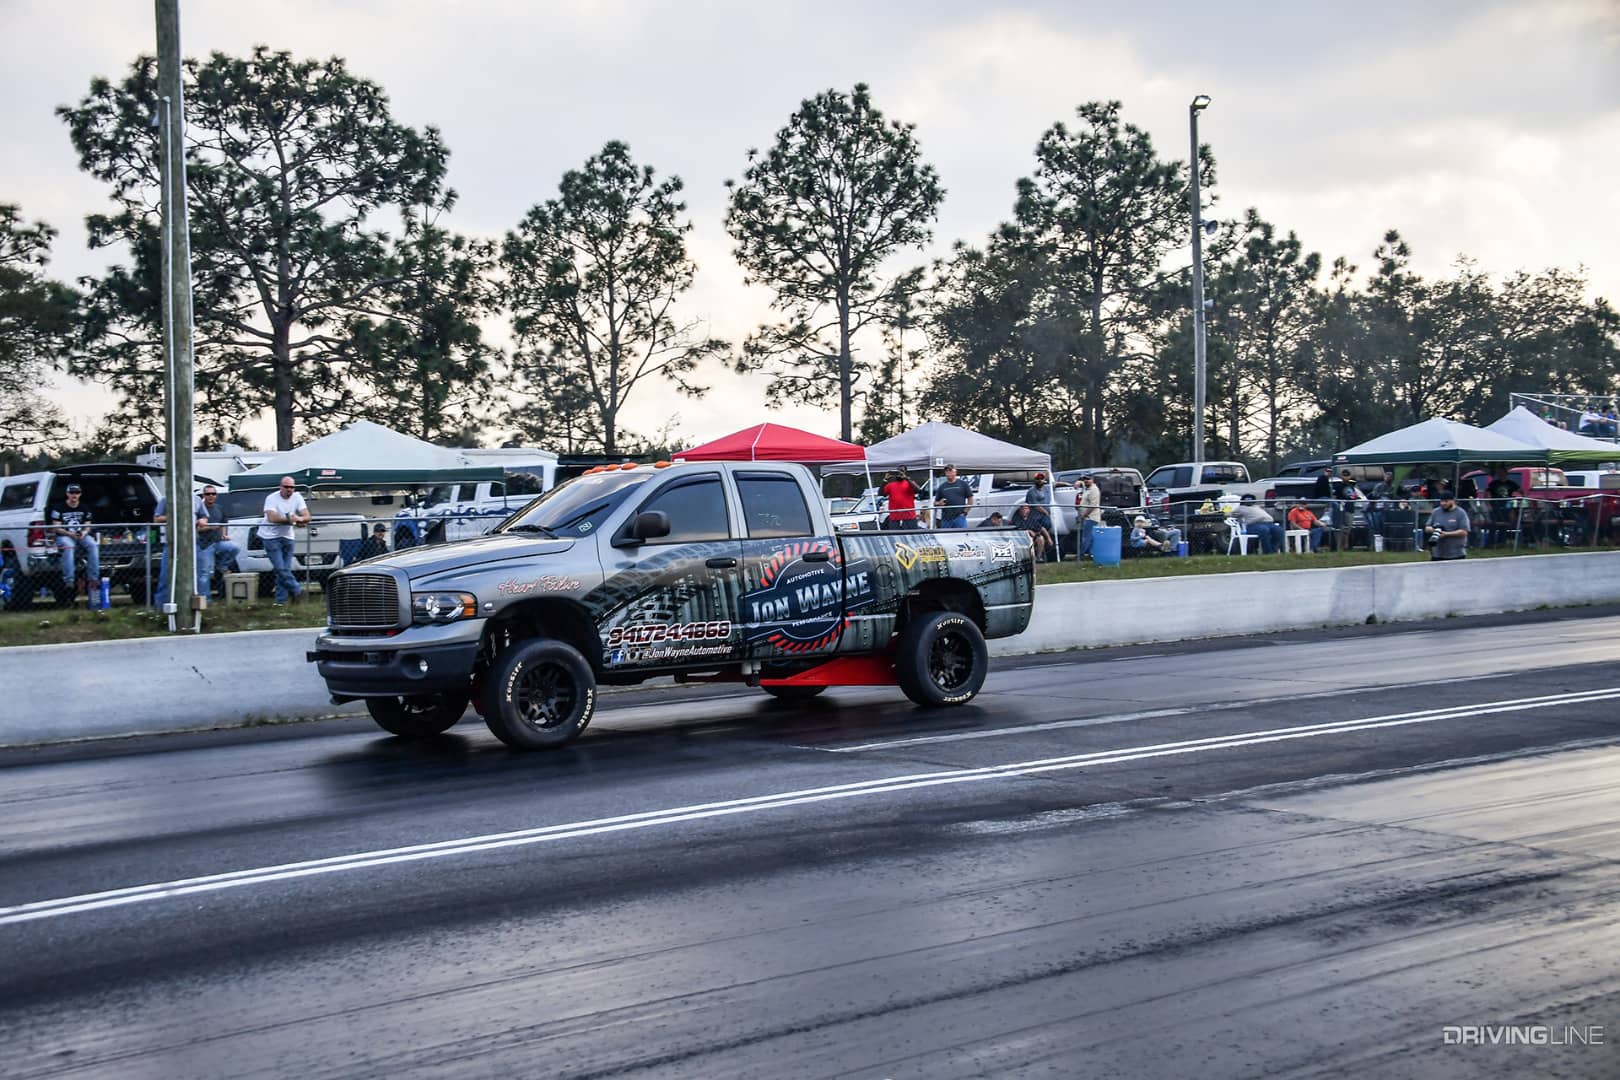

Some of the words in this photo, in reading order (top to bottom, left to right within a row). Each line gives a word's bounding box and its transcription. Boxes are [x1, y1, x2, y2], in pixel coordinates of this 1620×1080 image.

[786, 568, 825, 584] AUTOMOTIVE
[751, 596, 791, 628] JON
[795, 571, 871, 614] WAYNE
[642, 644, 733, 659] @JonWayneAutomotive
